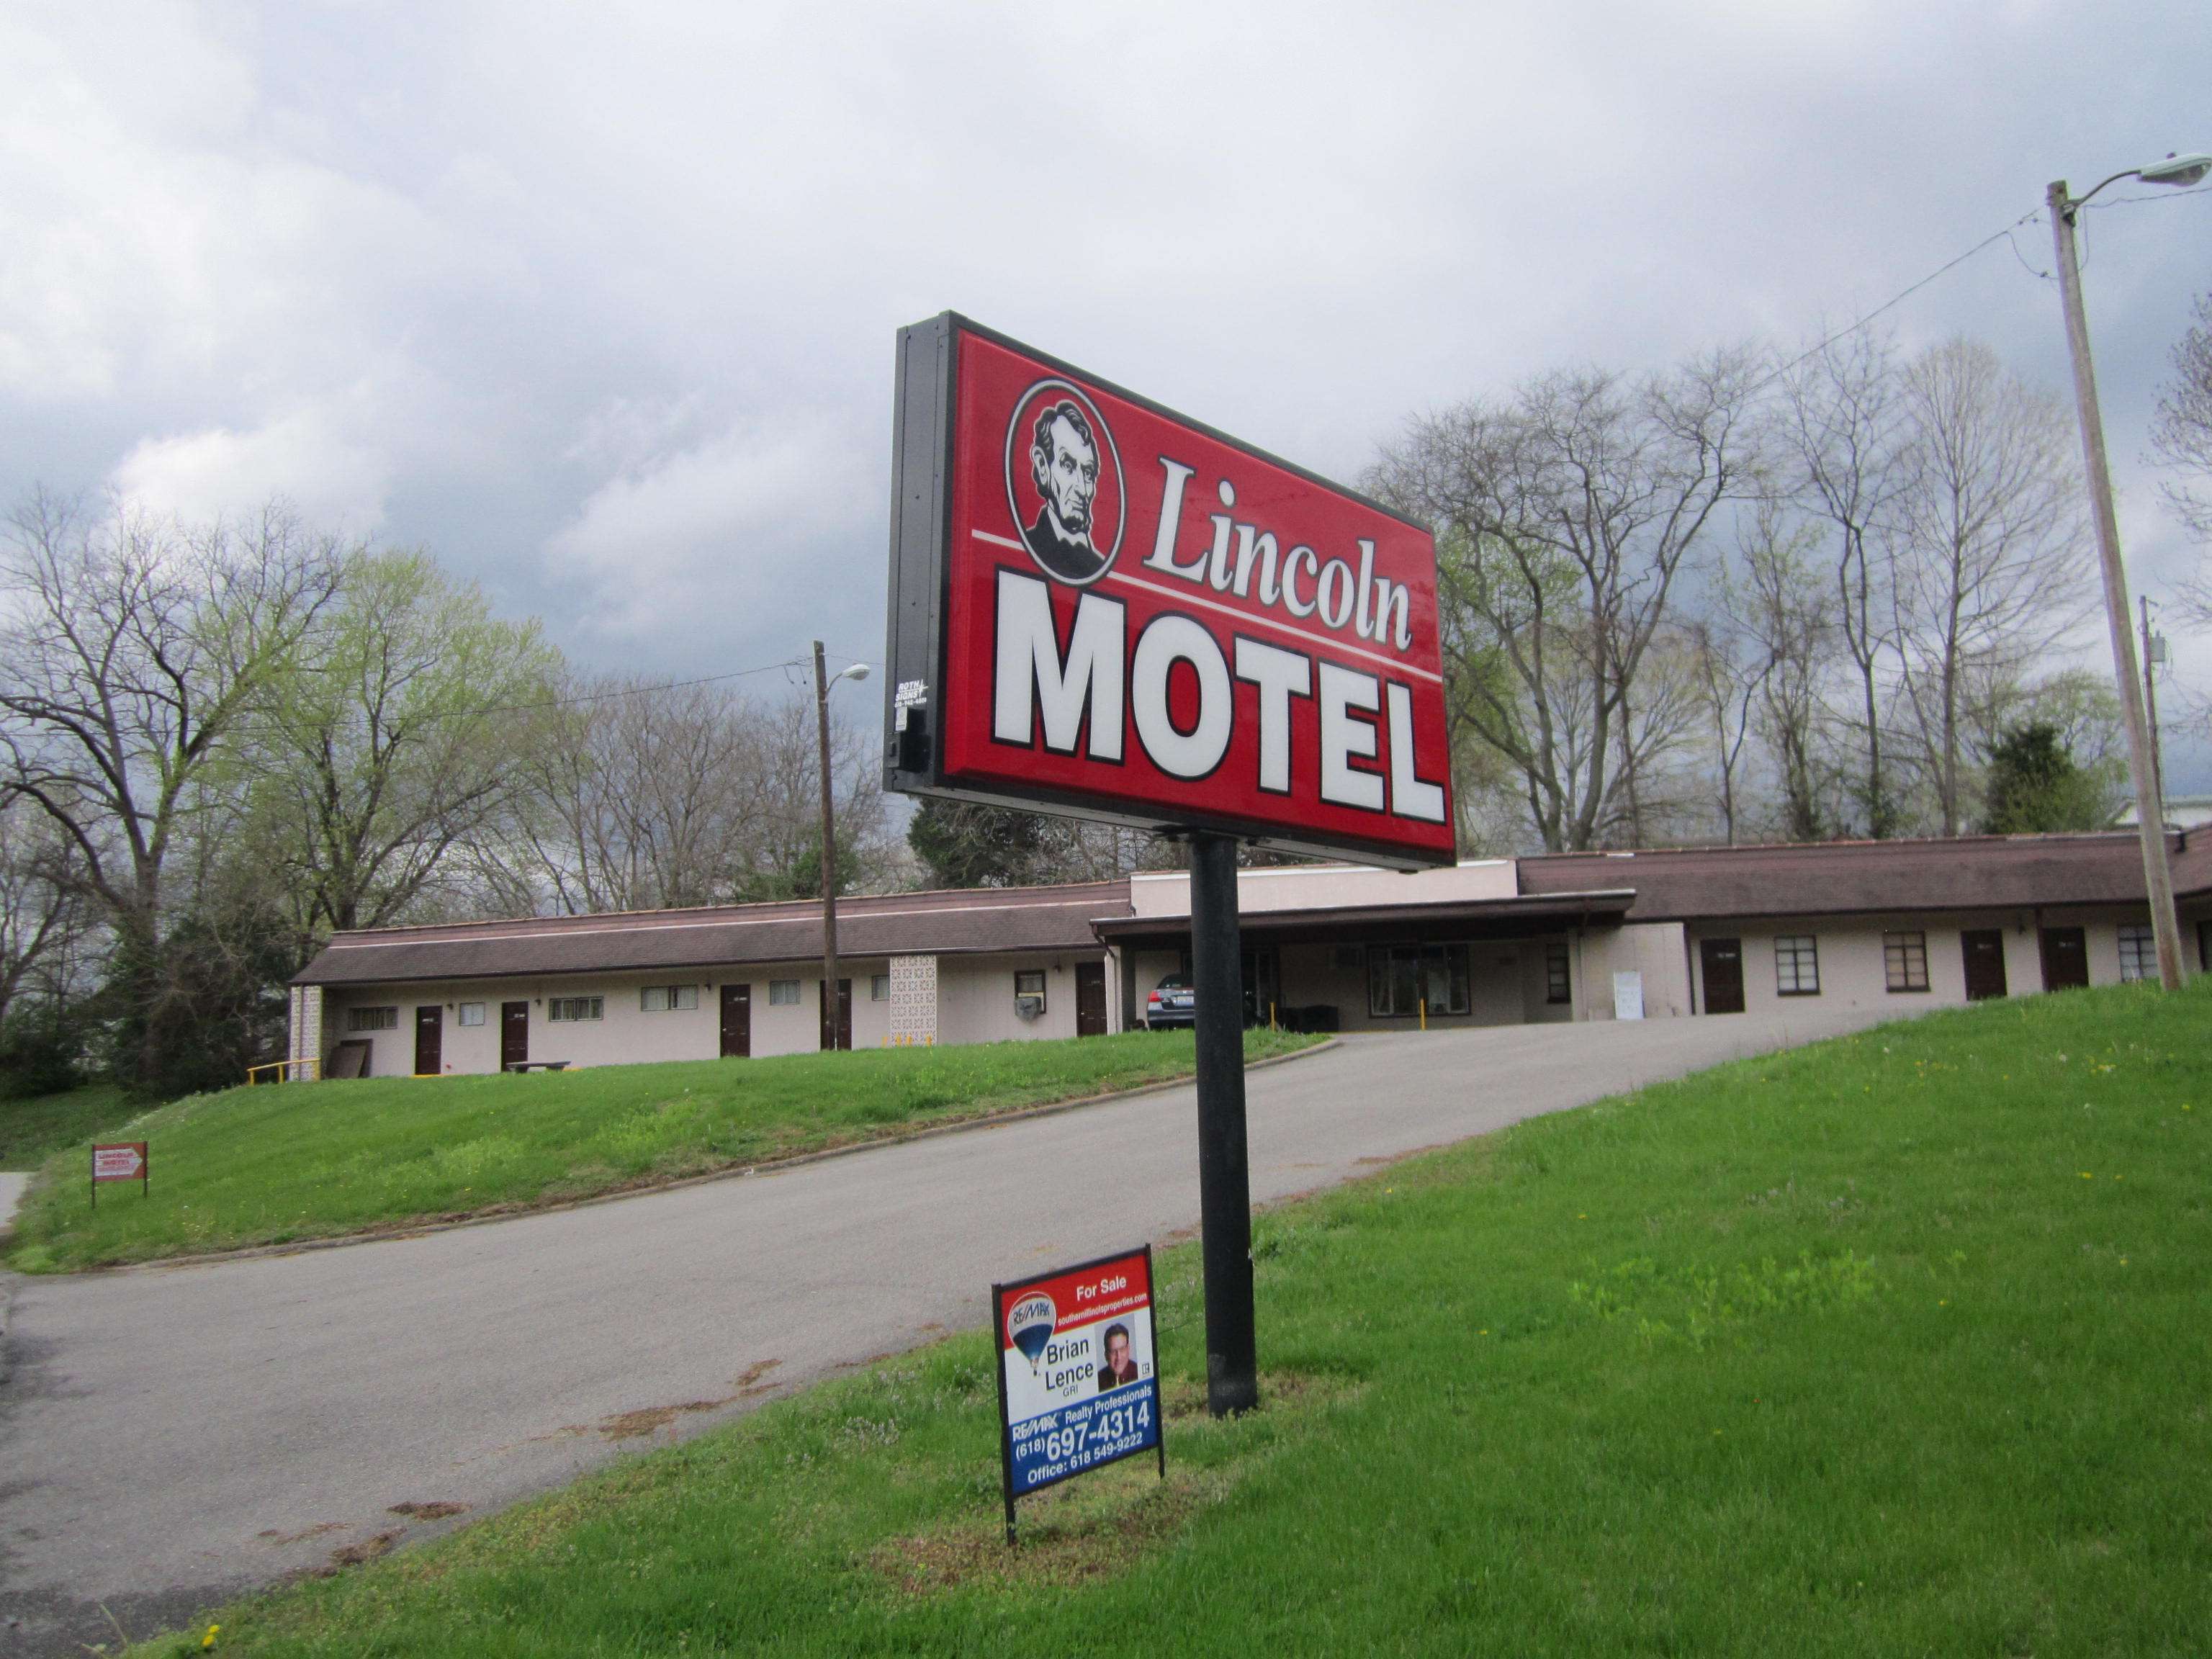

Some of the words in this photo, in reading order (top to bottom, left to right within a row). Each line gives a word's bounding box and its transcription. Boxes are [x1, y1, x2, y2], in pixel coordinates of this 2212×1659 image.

[1143, 455, 1412, 651] Lincoln
[895, 691, 917, 701] SIGNS
[899, 680, 920, 691] ROTH
[992, 565, 1445, 824] MOTEL
[1076, 1283, 1097, 1301] For
[1100, 1275, 1127, 1295] Sale
[1013, 1301, 1050, 1326] RE/MAX
[1058, 1292, 1147, 1326] southernillinoisproperties.com
[1046, 1337, 1089, 1365] Brian
[1046, 1362, 1094, 1391] Lence
[1063, 1386, 1079, 1398] GRI
[1012, 1414, 1058, 1442] RE/MAX
[1065, 1403, 1094, 1426] Realty
[1094, 1385, 1153, 1414] Professionals
[1015, 1437, 1046, 1462] (618)
[1047, 1401, 1150, 1461] 697-4314
[1027, 1462, 1068, 1485] Office:
[1070, 1451, 1092, 1470] 618
[1094, 1431, 1143, 1462] 549-9222
